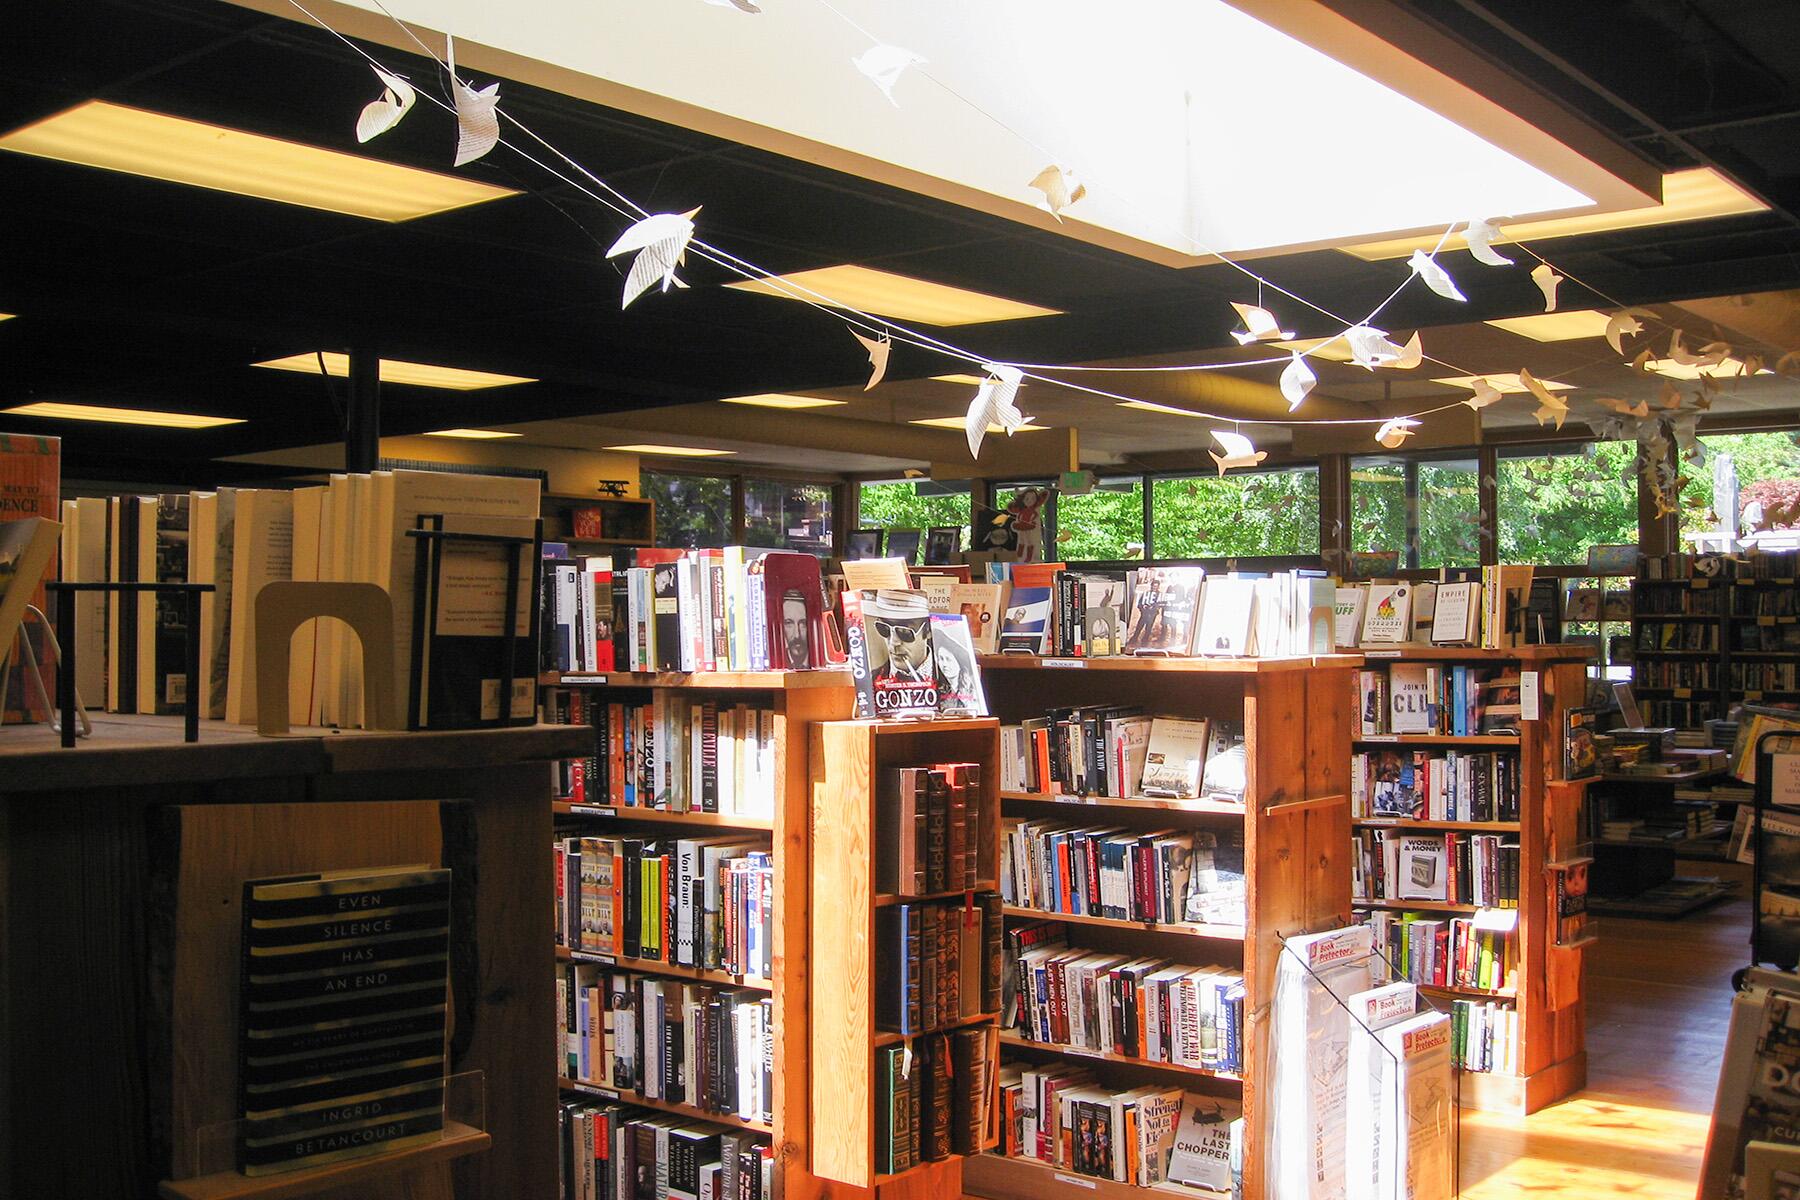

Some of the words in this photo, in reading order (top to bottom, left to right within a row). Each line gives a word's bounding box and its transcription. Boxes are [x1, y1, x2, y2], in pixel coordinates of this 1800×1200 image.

[1440, 590, 1467, 598] EMPIRE
[1336, 607, 1355, 616] UFF
[847, 626, 867, 680] GONZO
[876, 689, 938, 708] GONZO
[1393, 693, 1428, 713] CLU
[644, 720, 655, 768] GONZO
[681, 853, 692, 872] Von
[681, 874, 692, 909] Braun:
[338, 895, 382, 909] EVEN
[323, 920, 392, 938] SILENCE
[342, 948, 375, 963] HAS
[1320, 942, 1335, 953] Book
[324, 979, 347, 991] AN
[356, 974, 388, 988] END
[1187, 986, 1197, 1001] THE
[1380, 999, 1396, 1010] Book
[1189, 1003, 1199, 1036] PERFECT
[1415, 1033, 1430, 1045] Book
[1189, 1041, 1200, 1061] WAR
[323, 1103, 382, 1121] INGRID
[296, 1122, 407, 1155] BETANCOURT
[1202, 1137, 1231, 1151] LAST
[1212, 1129, 1231, 1141] THE
[1177, 1142, 1230, 1161] CHOPPER
